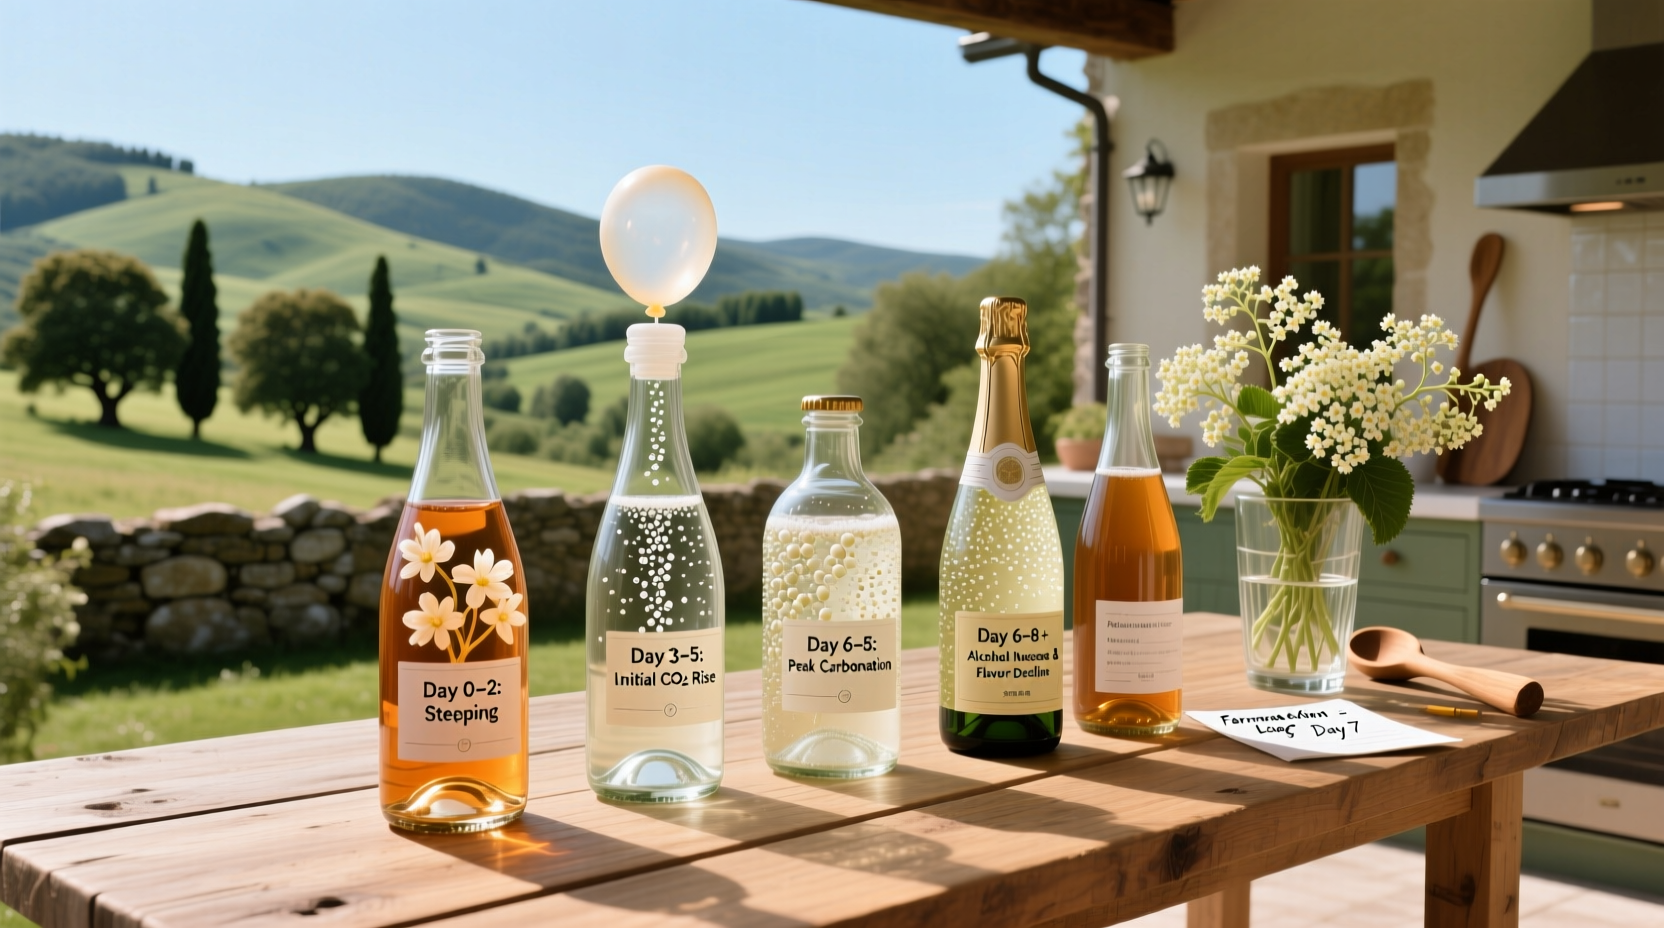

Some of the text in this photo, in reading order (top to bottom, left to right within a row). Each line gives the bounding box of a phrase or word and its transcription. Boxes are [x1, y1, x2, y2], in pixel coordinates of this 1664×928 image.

[807, 636, 839, 656] Day
[978, 627, 1008, 647] Day
[631, 647, 665, 668] Day
[788, 657, 892, 673] Peak Carbonation
[614, 671, 656, 686] Initial
[692, 670, 716, 685] Rise
[423, 681, 458, 703] Day
